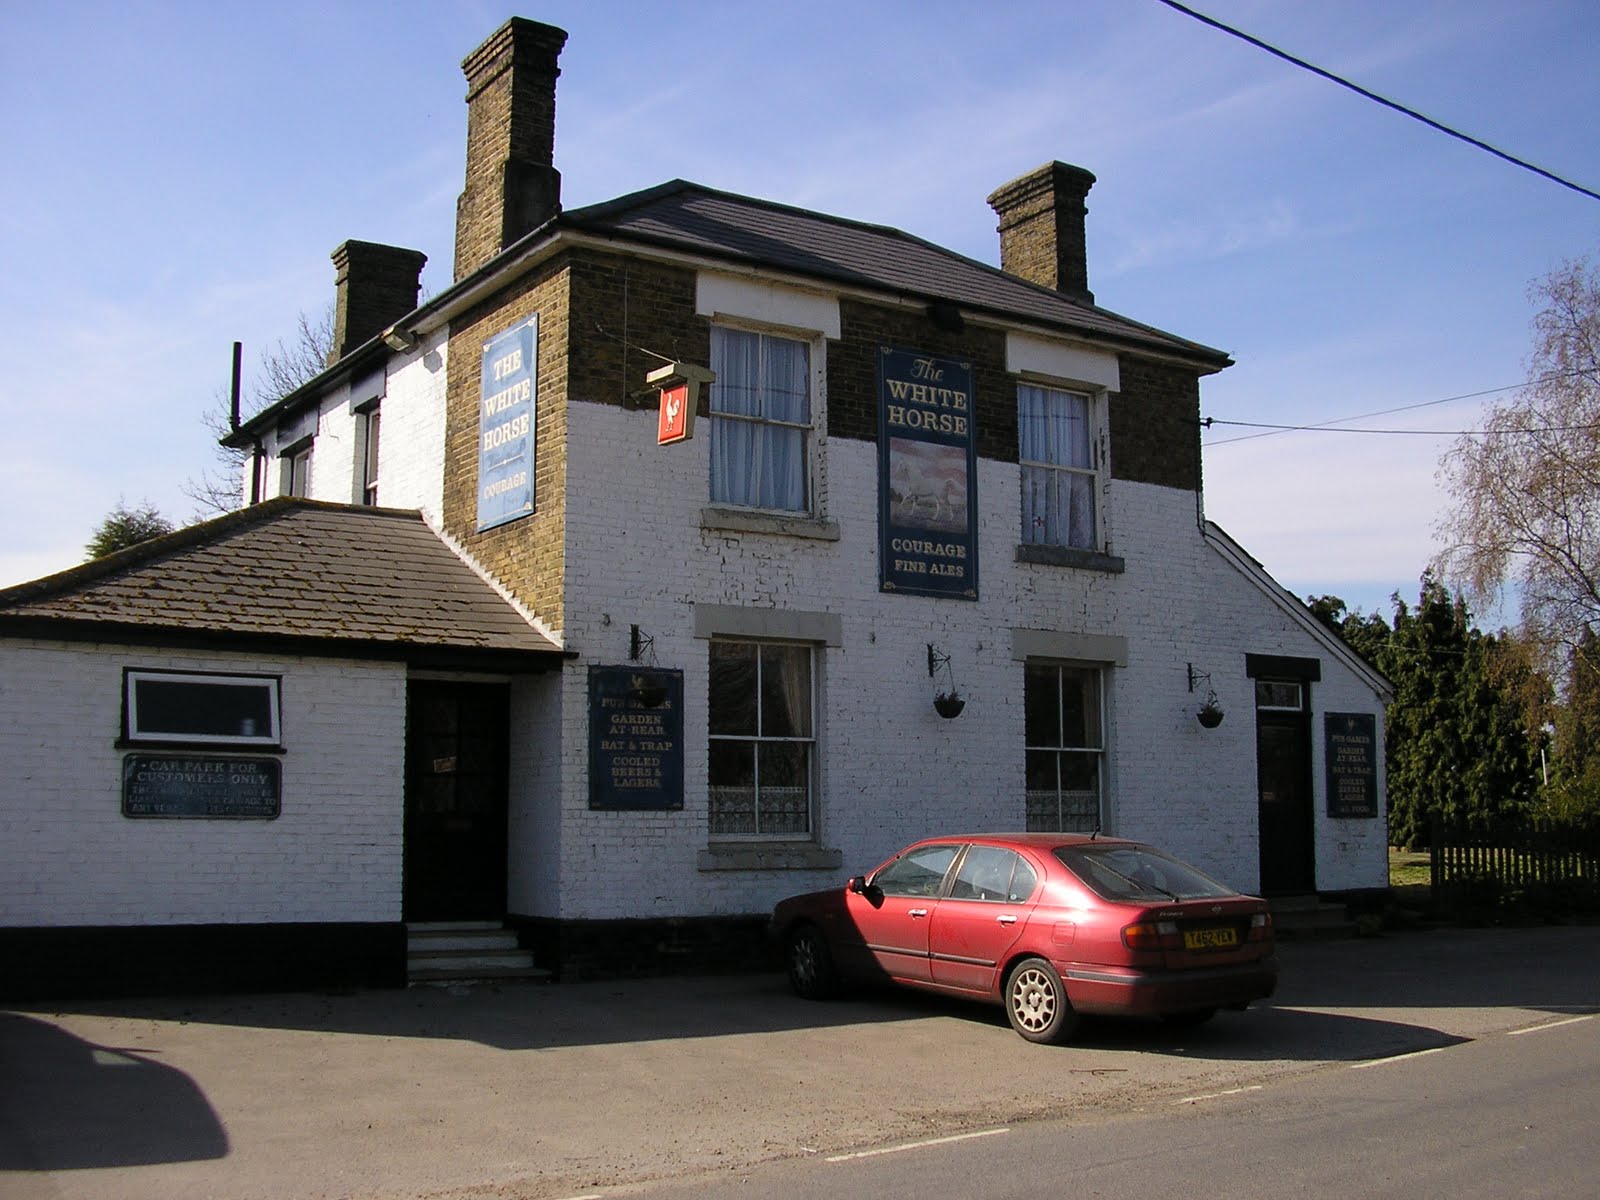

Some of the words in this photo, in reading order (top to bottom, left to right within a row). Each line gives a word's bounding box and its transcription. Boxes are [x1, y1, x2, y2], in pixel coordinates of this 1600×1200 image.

[493, 349, 522, 381] THE
[910, 358, 944, 381] The
[484, 378, 531, 417] WHITE
[886, 378, 967, 410] WHITE
[887, 404, 967, 435] HORSE
[483, 413, 530, 451] HORSE
[484, 471, 527, 499] COURAGE
[891, 538, 966, 559] COURAGE
[894, 559, 926, 573] FINE
[929, 563, 964, 577] ALES
[611, 714, 661, 725] GARDEN
[631, 726, 664, 735] REAR
[601, 740, 624, 750] BAT
[629, 741, 637, 751] &
[640, 741, 673, 751] TRAP
[150, 761, 180, 771] CAR
[184, 761, 225, 772] PARK
[229, 763, 257, 773] FOR
[612, 756, 660, 766] COOLED
[137, 771, 224, 784] CUSTOMERS
[231, 774, 268, 784] ONLY
[611, 767, 652, 777] BEERS
[614, 778, 660, 788] LAGERS
